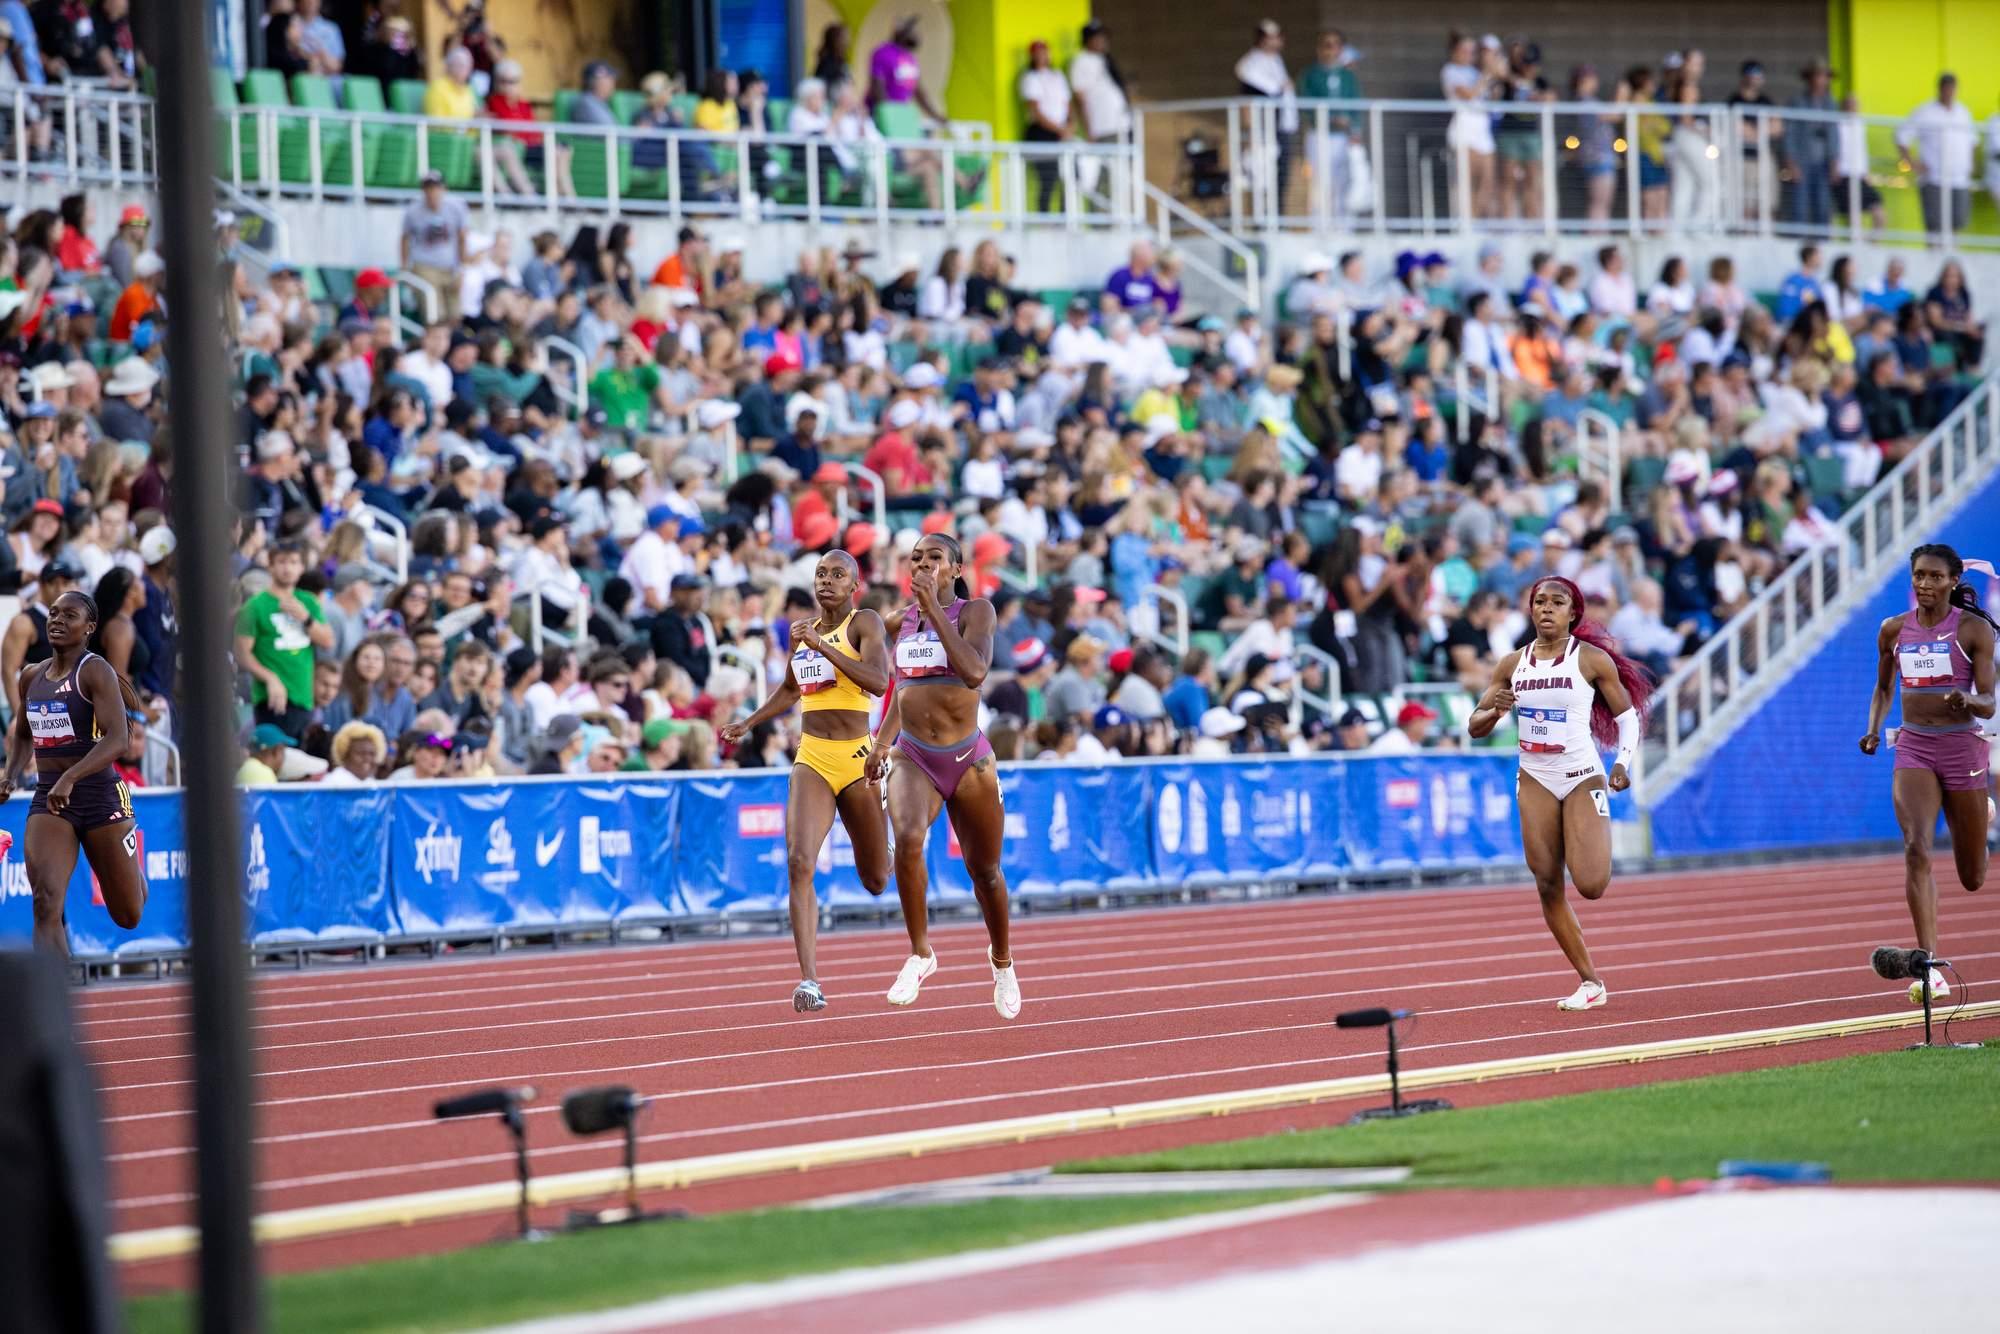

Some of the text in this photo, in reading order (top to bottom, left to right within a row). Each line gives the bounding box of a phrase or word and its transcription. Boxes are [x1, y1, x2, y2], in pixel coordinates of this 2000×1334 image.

[908, 648, 933, 658] HOLMES
[1914, 659, 1935, 669] HAYES
[800, 665, 821, 679] LITTLE
[1515, 677, 1573, 692] CAROLINA
[41, 718, 70, 730] JACKSON
[1531, 725, 1547, 735] FORD
[1565, 770, 1579, 778] TRACK
[1595, 791, 1608, 814] 2
[147, 851, 169, 880] ONE
